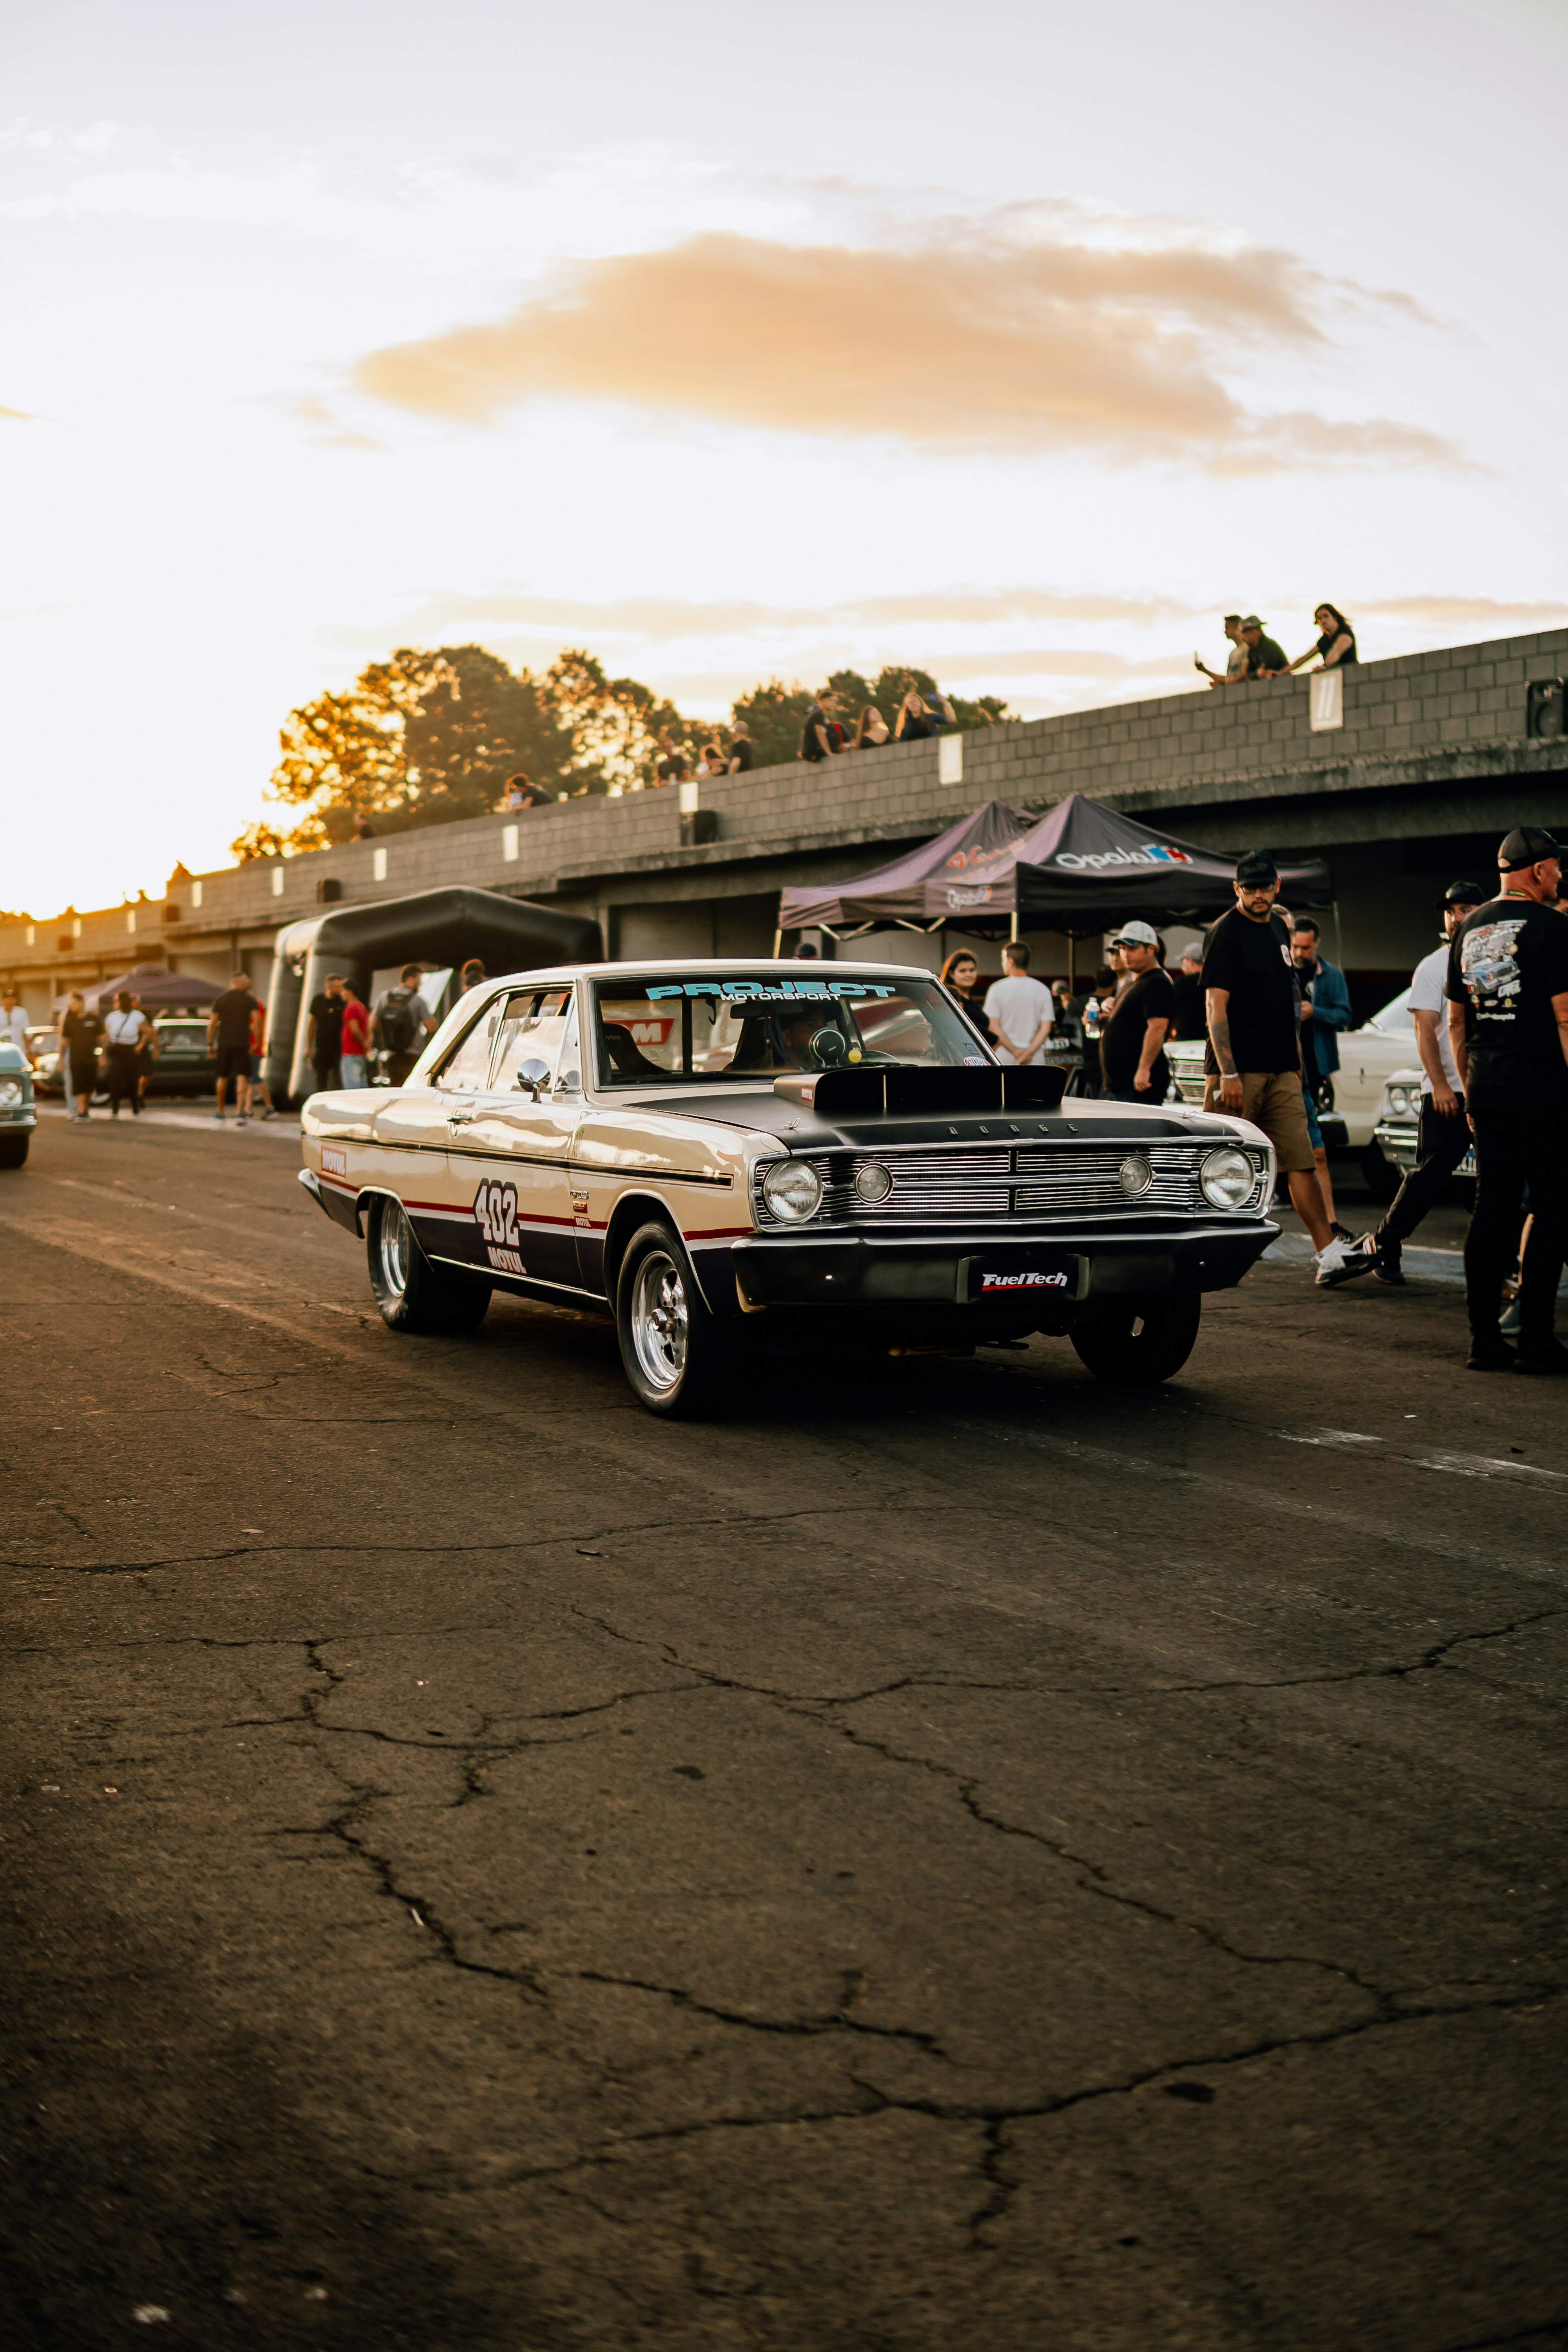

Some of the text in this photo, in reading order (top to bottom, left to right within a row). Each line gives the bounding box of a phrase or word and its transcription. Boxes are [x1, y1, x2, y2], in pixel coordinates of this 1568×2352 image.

[645, 982, 895, 1000] PROJECT
[948, 1123, 1078, 1134] DODGE
[322, 1150, 345, 1175] MOTUL
[474, 1182, 520, 1247] 402
[575, 1217, 591, 1227] MOTUL
[487, 1246, 527, 1274] MOTUL
[982, 1272, 1068, 1287] FuelTech
